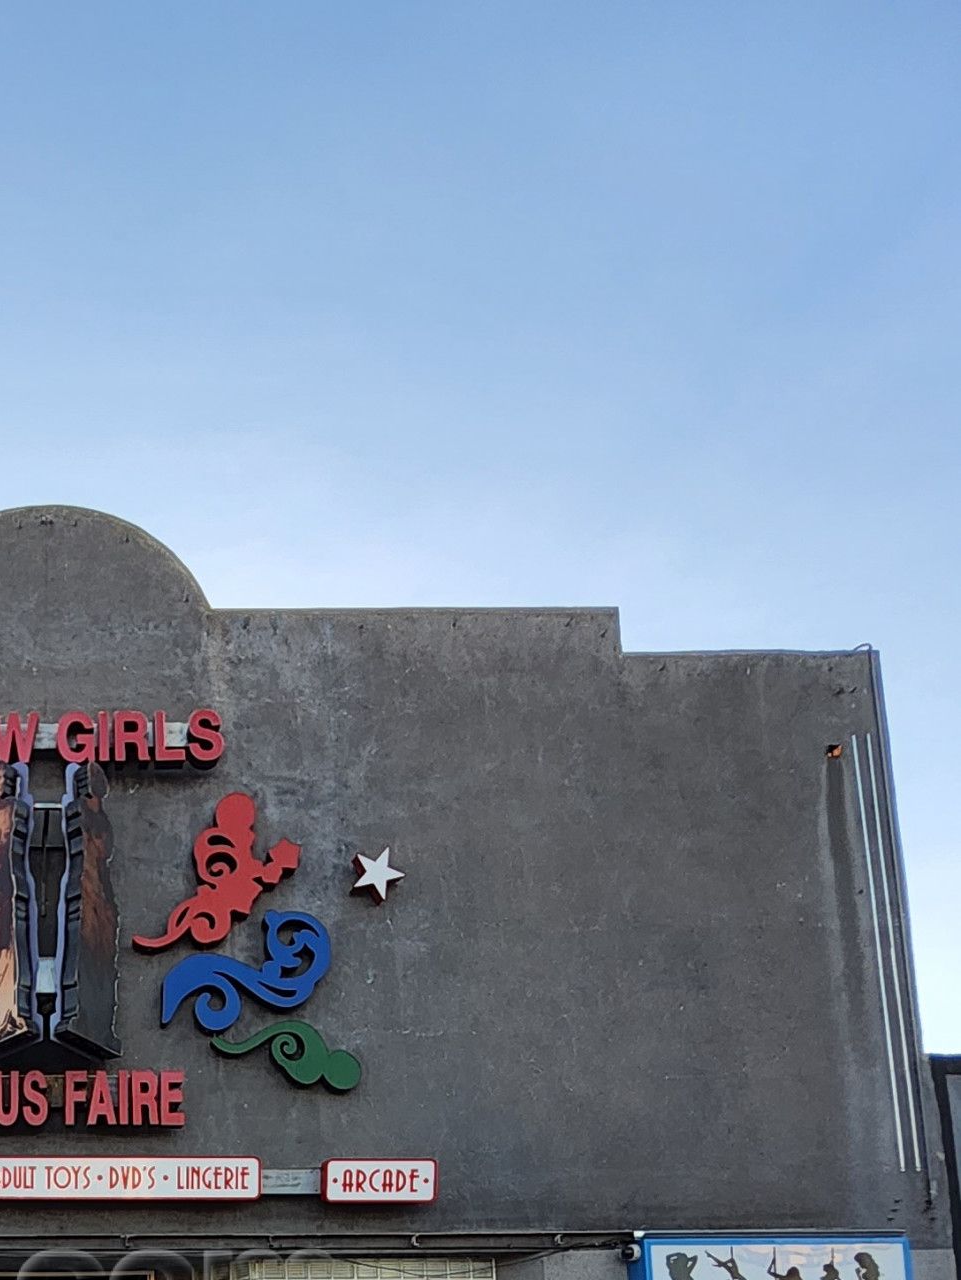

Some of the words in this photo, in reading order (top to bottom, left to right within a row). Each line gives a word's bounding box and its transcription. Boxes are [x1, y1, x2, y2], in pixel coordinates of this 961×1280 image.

[56, 709, 226, 762] GIRLS
[64, 1069, 186, 1127] FAIRE
[44, 1166, 91, 1190] TOYS
[109, 1166, 155, 1190] DVD'S
[177, 1166, 250, 1190] LINGERIE
[341, 1168, 420, 1193] ARCADE
